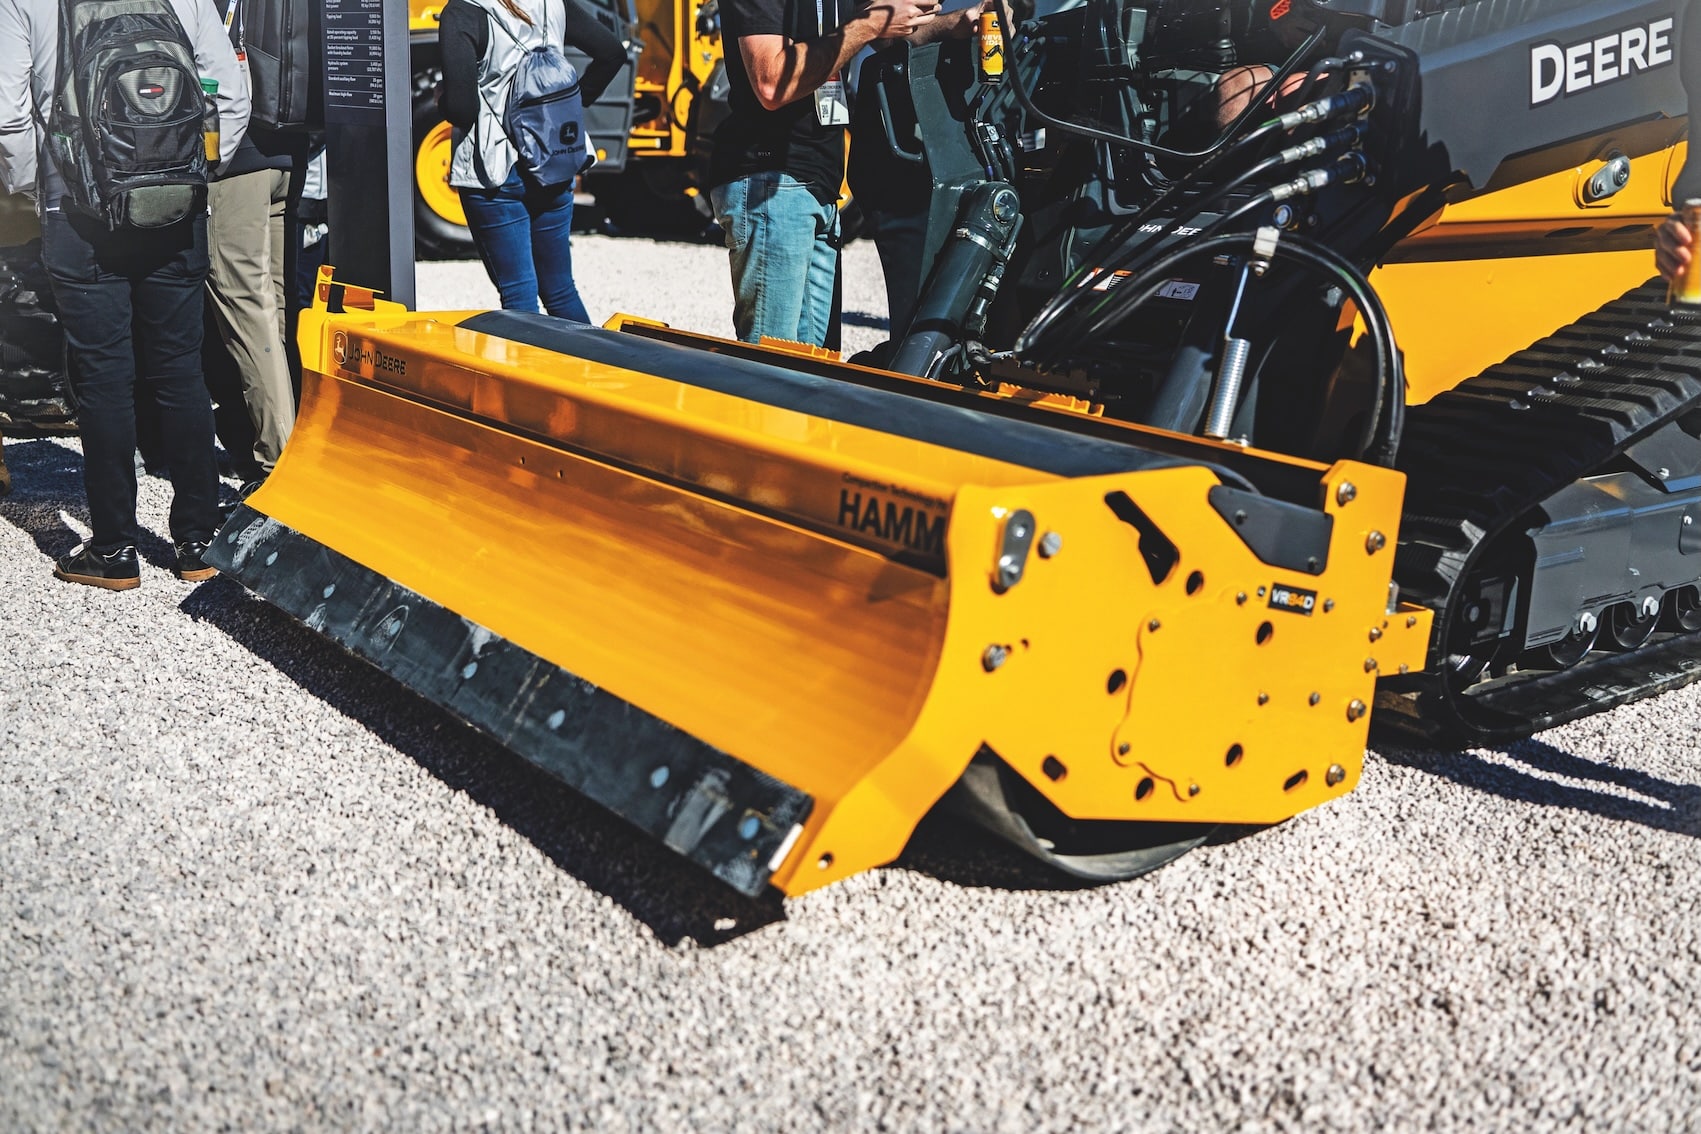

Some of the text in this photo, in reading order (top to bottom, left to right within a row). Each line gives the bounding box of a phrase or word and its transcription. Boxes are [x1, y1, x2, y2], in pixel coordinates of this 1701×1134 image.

[1531, 17, 1673, 104] DEERE
[349, 343, 407, 376] JOHN DEERE
[1272, 588, 1314, 610] VR84D
